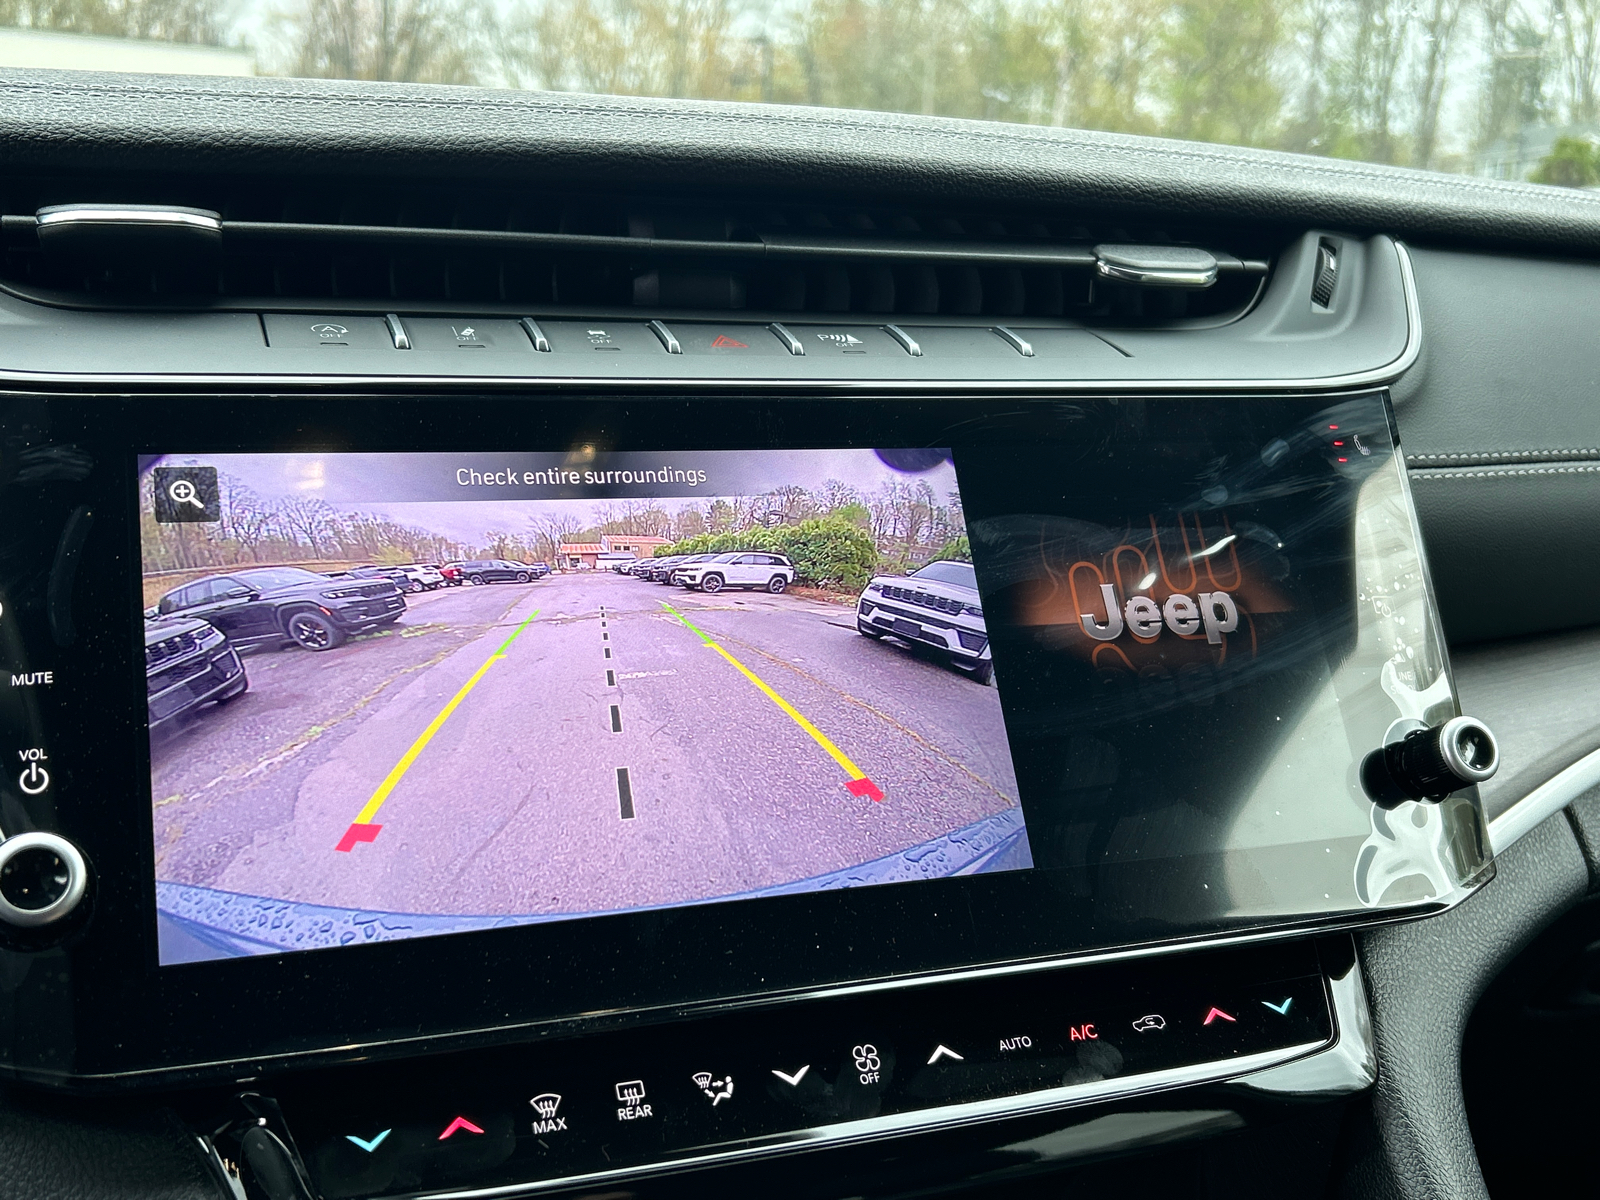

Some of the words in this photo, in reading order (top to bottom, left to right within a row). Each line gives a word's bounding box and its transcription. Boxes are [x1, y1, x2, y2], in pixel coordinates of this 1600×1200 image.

[456, 467, 519, 486] Check
[523, 467, 581, 485] entire
[584, 466, 708, 486] surroundings
[1080, 583, 1239, 645] Jeep
[11, 671, 54, 687] MUTE
[18, 747, 48, 761] VOL
[1070, 1023, 1099, 1042] A/C
[999, 1035, 1032, 1051] AUTO
[858, 1071, 881, 1086] OFF
[617, 1103, 653, 1122] REAR
[532, 1115, 568, 1135] MAX
